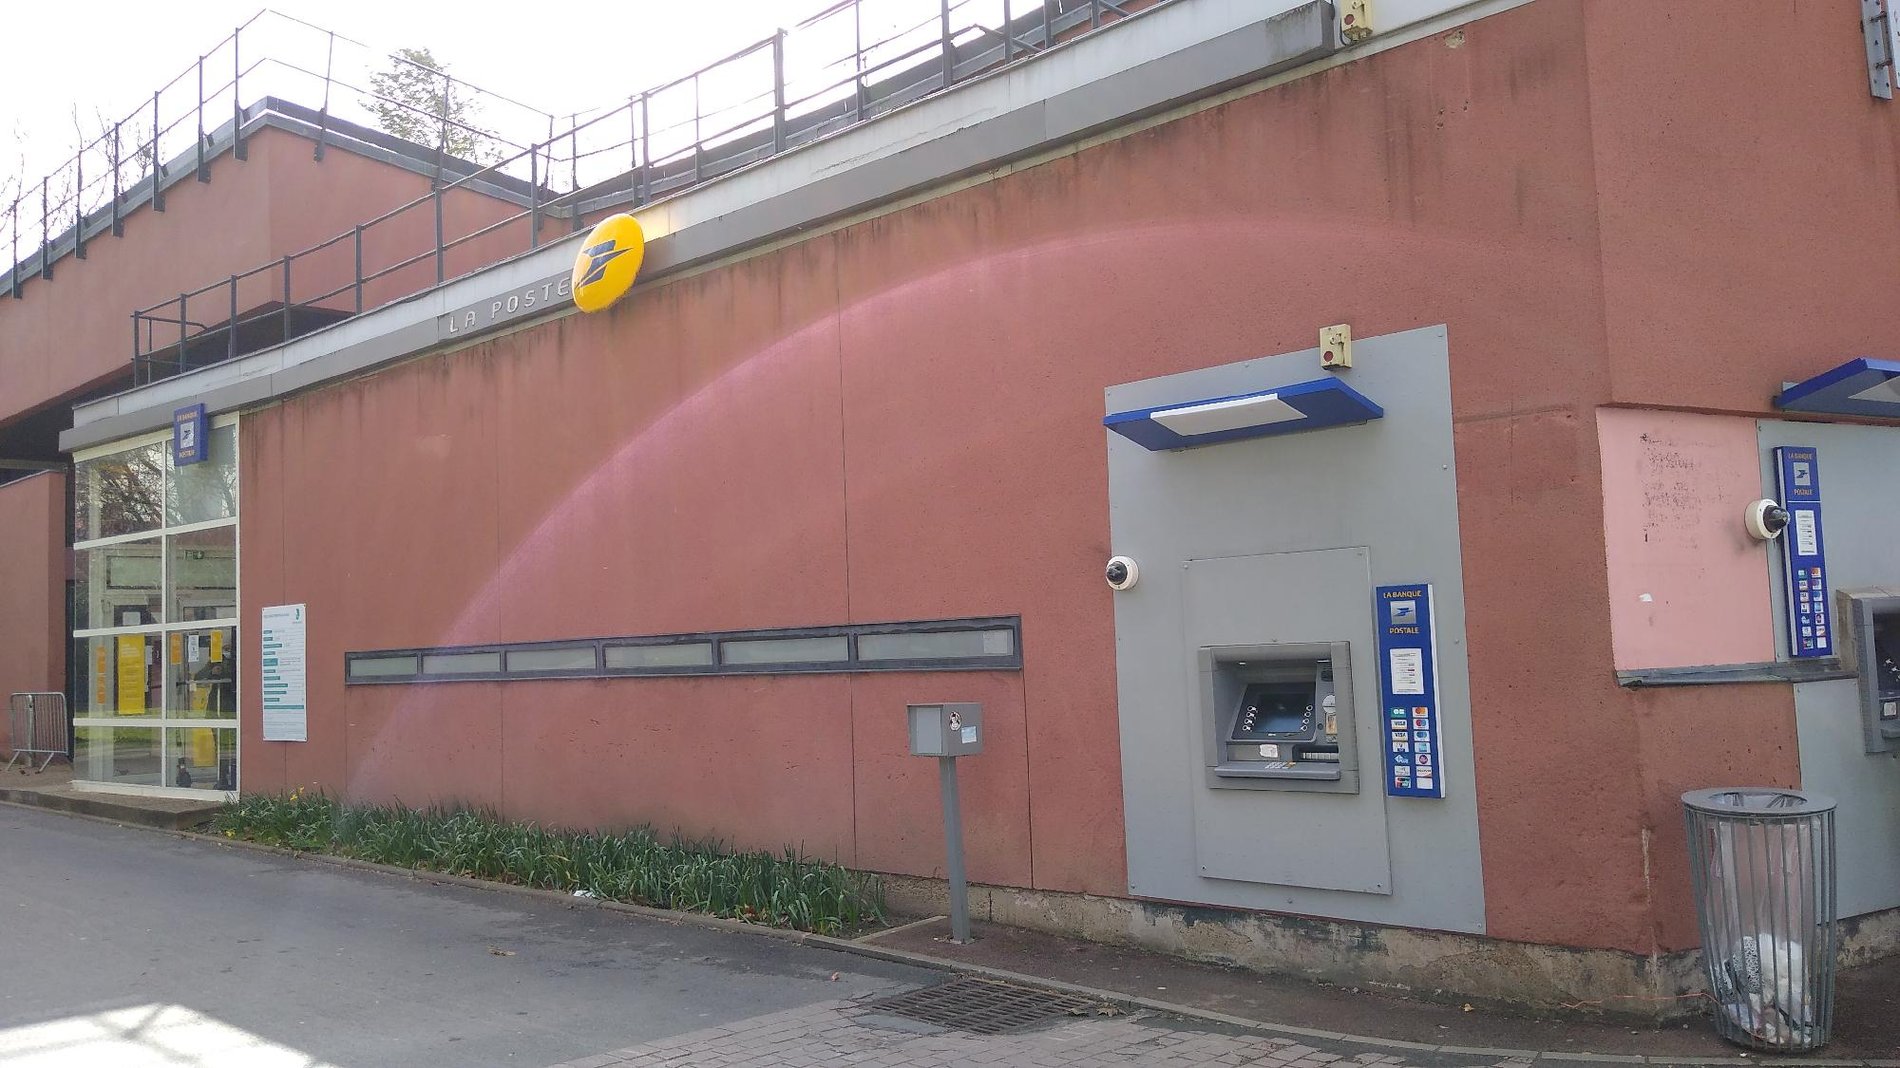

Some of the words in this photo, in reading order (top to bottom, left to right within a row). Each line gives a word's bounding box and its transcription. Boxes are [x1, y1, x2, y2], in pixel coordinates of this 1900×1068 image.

[449, 311, 476, 334] LA
[491, 276, 570, 320] POSTE
[1392, 590, 1422, 598] BANQUE
